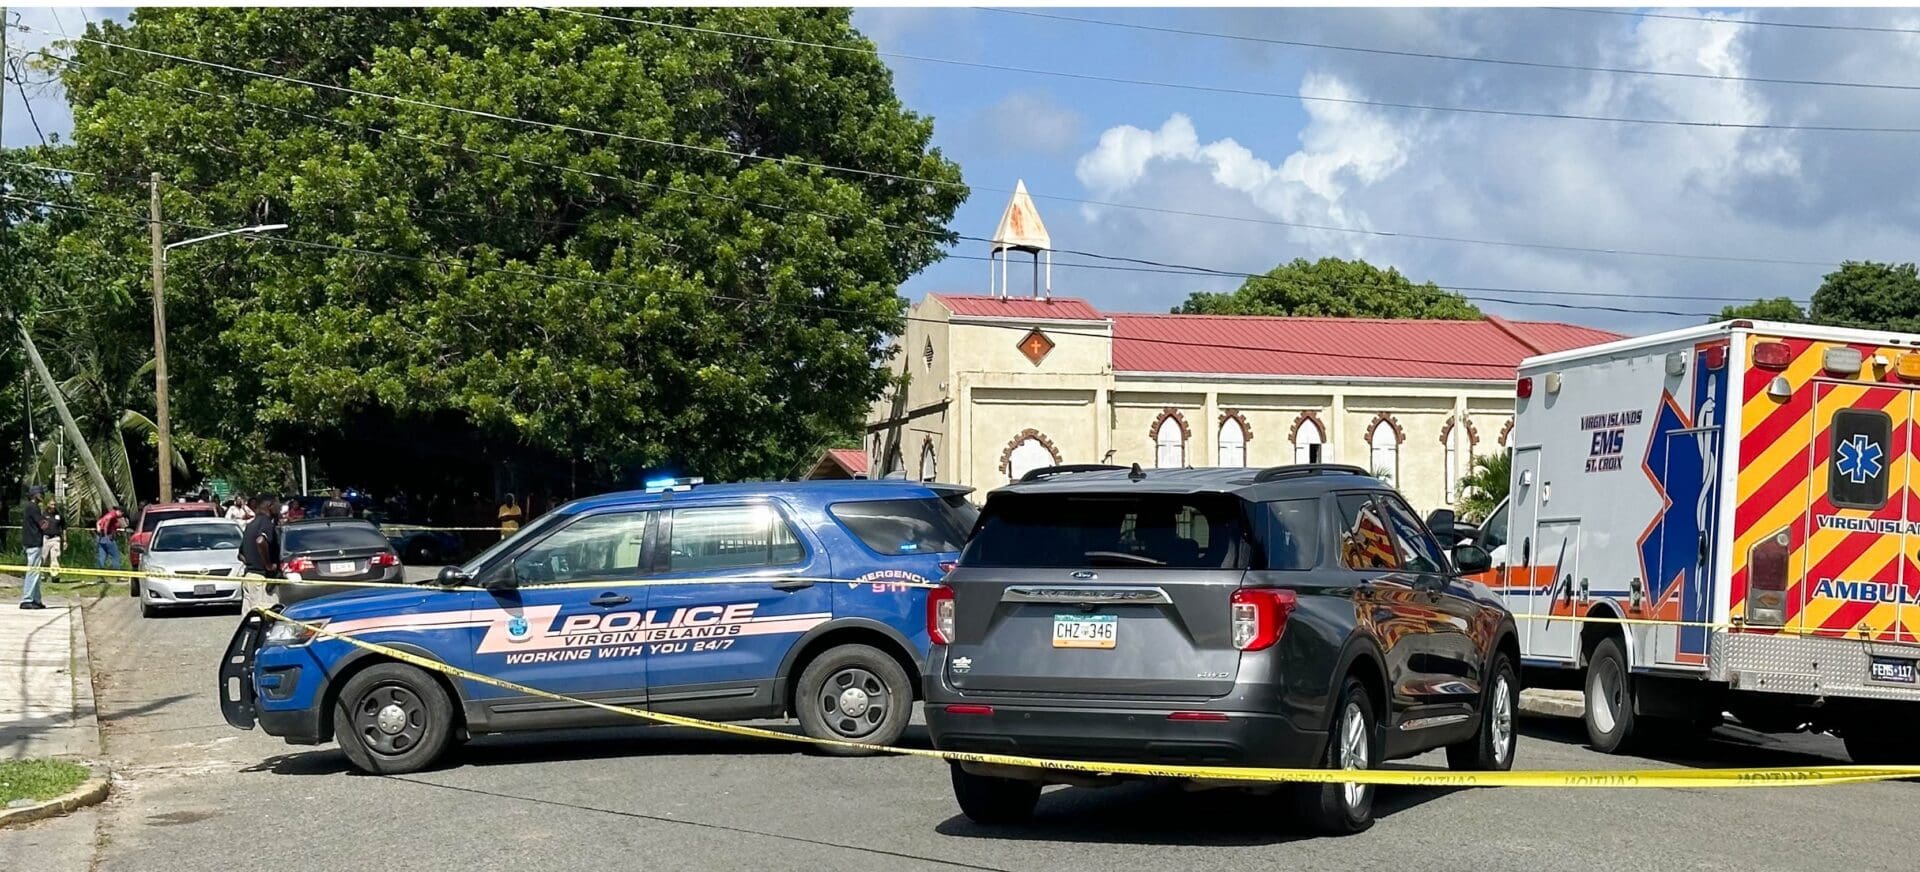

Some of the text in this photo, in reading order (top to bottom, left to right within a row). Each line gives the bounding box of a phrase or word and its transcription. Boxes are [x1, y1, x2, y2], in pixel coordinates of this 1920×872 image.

[1581, 409, 1643, 431] VIRGIN ISLANDS
[1590, 428, 1625, 457] EMS
[1584, 456, 1624, 473] ST. CROIX
[1818, 516, 1876, 531] VIRGIN
[560, 602, 760, 636] POLICE
[565, 625, 741, 646] VIRGIN ISLANDS
[1057, 623, 1112, 638] CHZ 346
[506, 639, 734, 664] WORKING WITH YOU 24/7
